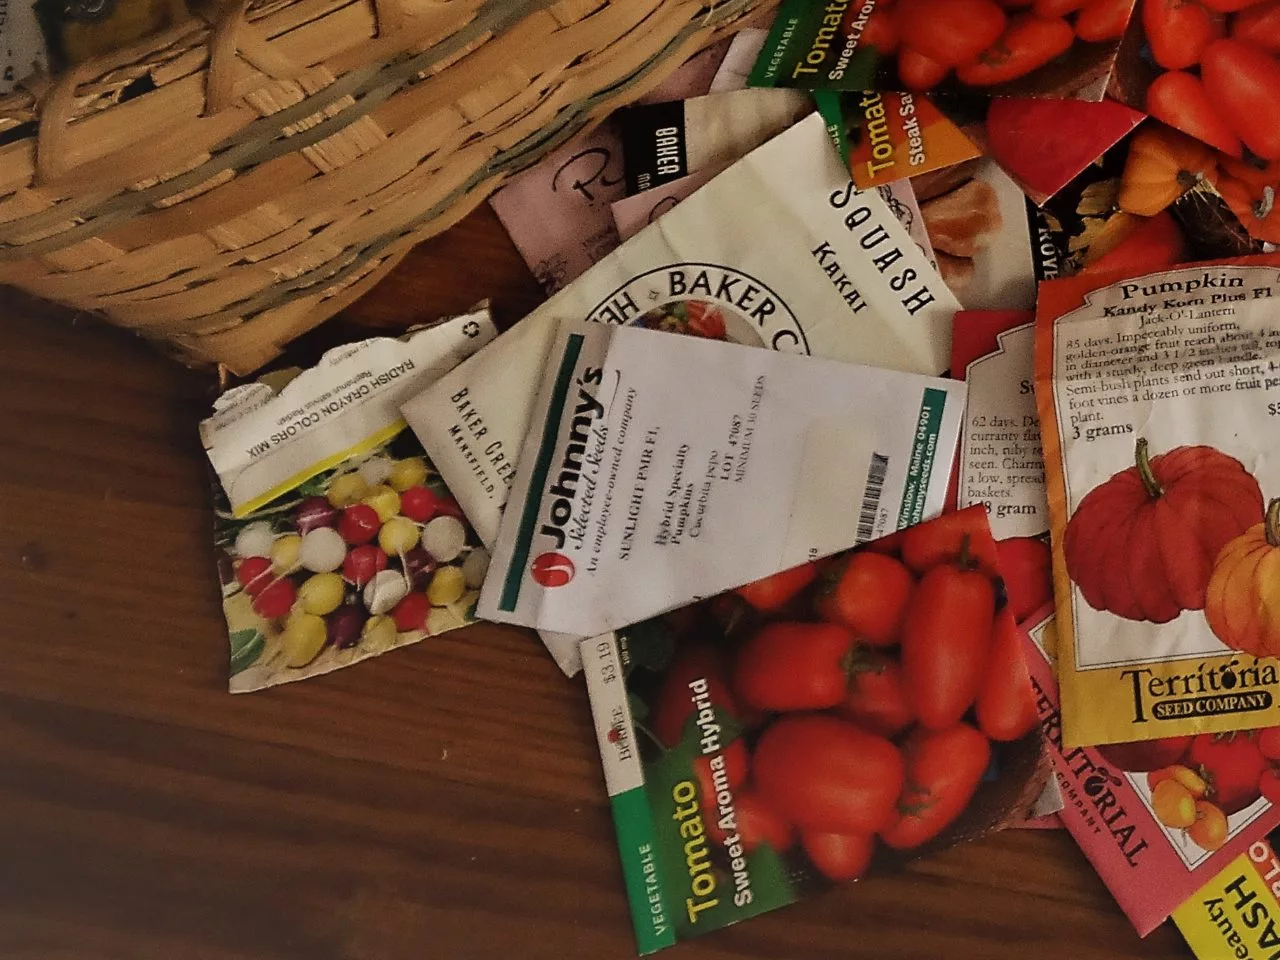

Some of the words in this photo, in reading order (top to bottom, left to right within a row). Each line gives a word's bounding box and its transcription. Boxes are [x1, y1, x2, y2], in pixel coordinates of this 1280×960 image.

[765, 17, 799, 79] VEGETABLE
[828, 31, 863, 81] Sweet
[656, 126, 678, 175] BAKER
[858, 89, 896, 180] Tomat
[903, 117, 926, 166] Steak
[829, 180, 935, 316] SQUASH
[668, 269, 777, 323] BAKER
[812, 240, 868, 314] KAKAI
[1122, 273, 1244, 302] Pumpkin
[1103, 300, 1158, 318] Kandy
[1163, 295, 1205, 311] Korn
[1211, 291, 1247, 305] Plus
[369, 358, 414, 390] RADISH
[1069, 397, 1094, 410] foot
[1142, 386, 1179, 401] dozen
[1183, 387, 1196, 397] or
[1200, 382, 1232, 395] more
[1235, 375, 1262, 392] fruit
[1134, 375, 1169, 391] plants
[1173, 370, 1203, 384] send
[1206, 368, 1226, 380] out
[1229, 362, 1265, 378] short,
[319, 383, 370, 417] CRAYON
[451, 387, 485, 441] BAKER
[618, 386, 637, 443] company
[914, 405, 932, 440] 04901
[1070, 409, 1104, 426] plant.
[245, 439, 270, 458] MIX
[270, 411, 320, 445] COLORS
[1072, 427, 1081, 440] 3
[1085, 423, 1133, 444] grams
[447, 424, 495, 500] MANSFIELD,
[540, 366, 603, 550] Johnny's
[666, 442, 690, 498] Specialty
[907, 441, 925, 476] Maine
[671, 480, 696, 545] Pumpkins
[997, 503, 1037, 518] gram
[599, 642, 618, 685] $3.19
[688, 677, 721, 755] Hybrid
[1157, 700, 1193, 718] SEED
[1196, 694, 1267, 714] COMPANY
[709, 755, 737, 833] Aroma
[672, 780, 720, 924] Tomato
[724, 835, 754, 908] Sweet
[639, 843, 665, 936] VEGETABLE
